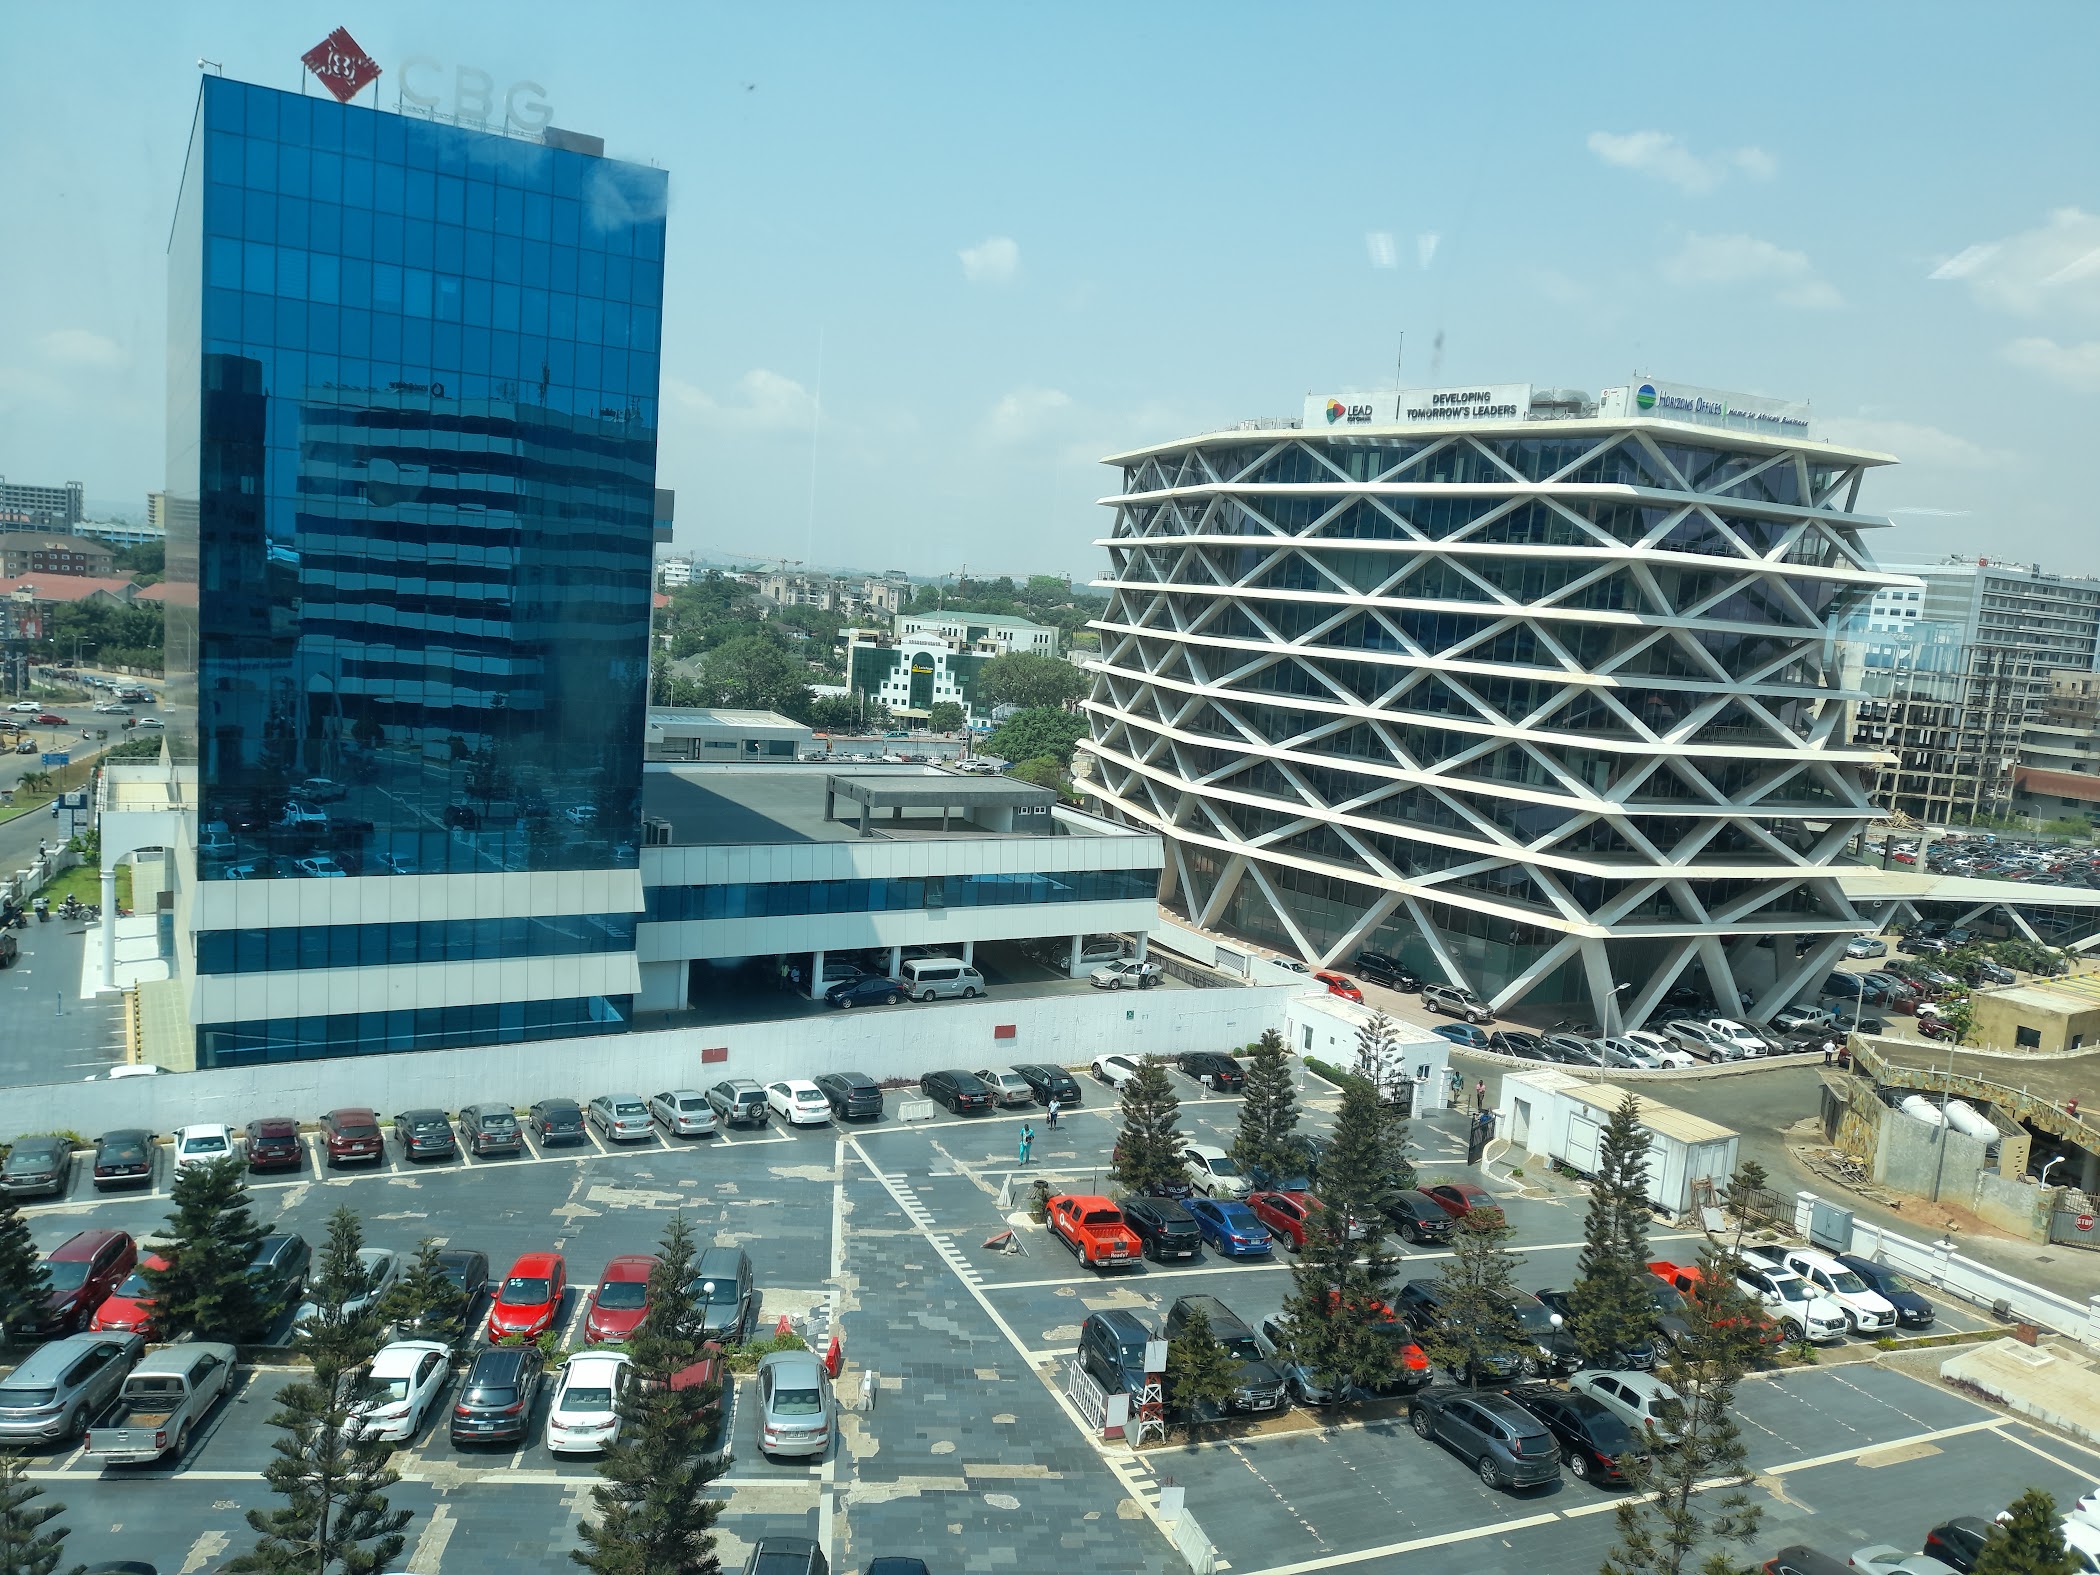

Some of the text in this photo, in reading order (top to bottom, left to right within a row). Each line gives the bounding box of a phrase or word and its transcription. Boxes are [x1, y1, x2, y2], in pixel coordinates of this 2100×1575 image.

[399, 55, 553, 131] CBG
[1433, 392, 1491, 404] DEVELOPING
[1348, 405, 1373, 416] LEAD
[1407, 404, 1517, 418] TOMORROW'S LEADERS
[1781, 416, 1808, 427] Business
[2076, 1218, 2093, 1226] STOP
